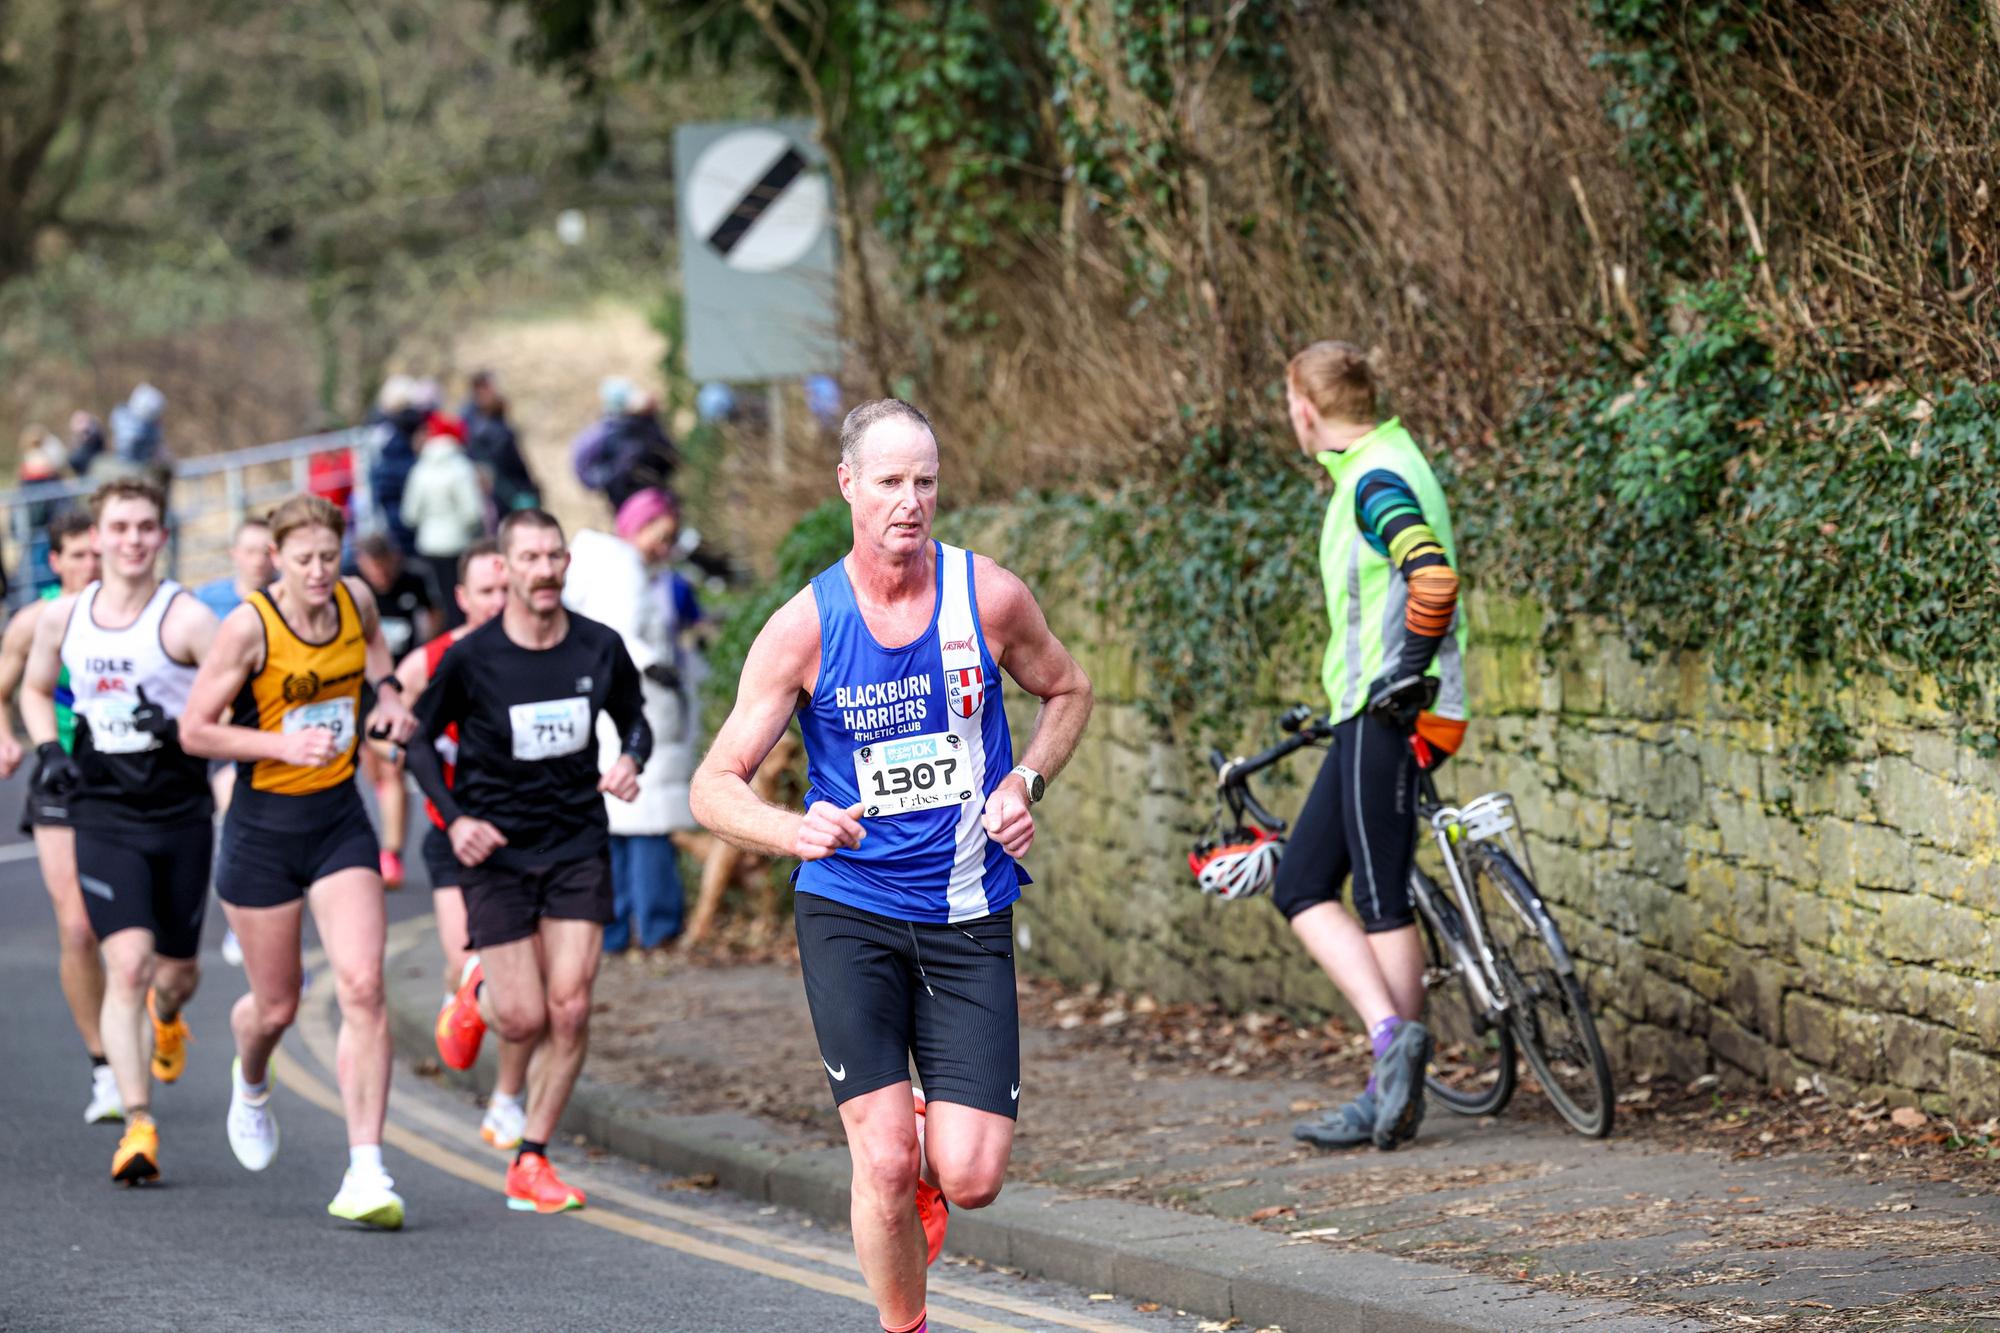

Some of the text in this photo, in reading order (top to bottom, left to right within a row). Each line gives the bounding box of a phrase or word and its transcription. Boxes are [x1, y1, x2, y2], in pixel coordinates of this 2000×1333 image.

[85, 658, 133, 672] IDLE
[835, 673, 931, 708] BLACKBURN
[843, 698, 927, 731] HARRIERS
[532, 721, 575, 743] 714
[854, 721, 921, 742] ATHLETIC CLUB
[911, 740, 935, 758] 10K
[872, 758, 957, 796] 1307
[900, 793, 939, 808] Frbes
